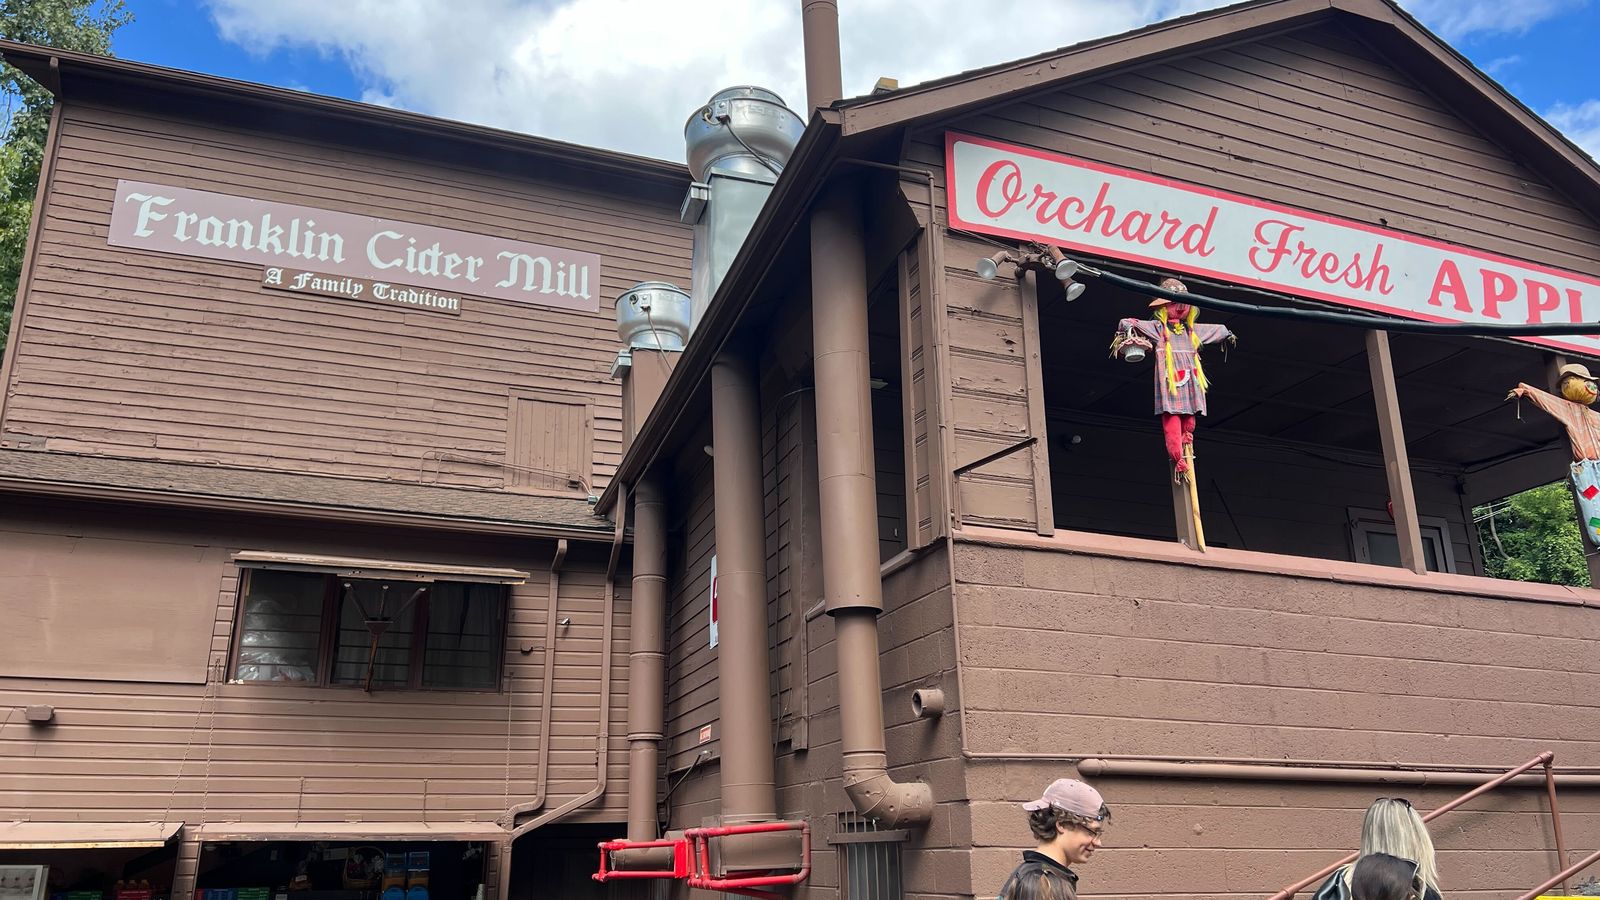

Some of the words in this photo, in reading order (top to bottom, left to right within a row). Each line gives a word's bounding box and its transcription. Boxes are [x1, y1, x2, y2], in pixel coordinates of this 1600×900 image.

[126, 192, 346, 264] Franklin
[366, 231, 484, 283] Cider
[496, 250, 592, 301] Mill
[976, 159, 1218, 258] Orchard
[1248, 219, 1395, 297] Fresh
[265, 268, 283, 286] A
[289, 272, 364, 299] Family
[372, 280, 459, 311] Tradition
